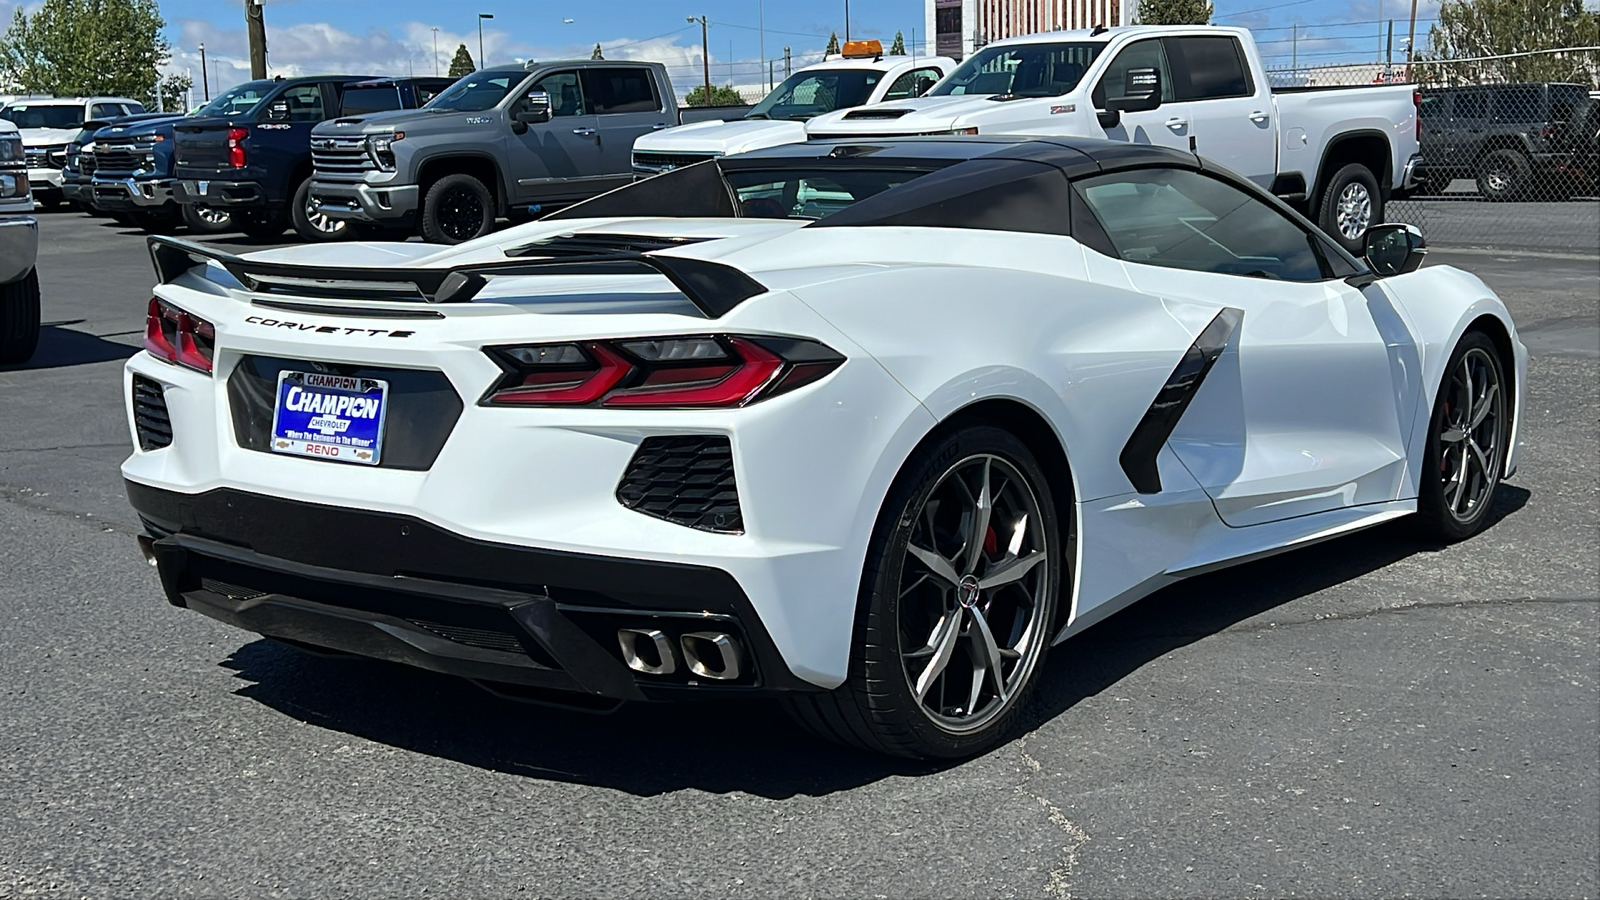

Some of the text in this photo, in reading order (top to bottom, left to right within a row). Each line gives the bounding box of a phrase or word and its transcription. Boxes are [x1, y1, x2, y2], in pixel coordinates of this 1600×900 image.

[245, 316, 416, 338] CORVETTE
[307, 374, 357, 389] CHAMPION
[286, 386, 379, 419] CHAMPION
[311, 419, 347, 429] CHEVROLET
[303, 432, 312, 440] The
[313, 434, 336, 443] Customer
[342, 436, 351, 445] The
[306, 444, 339, 456] RENO
